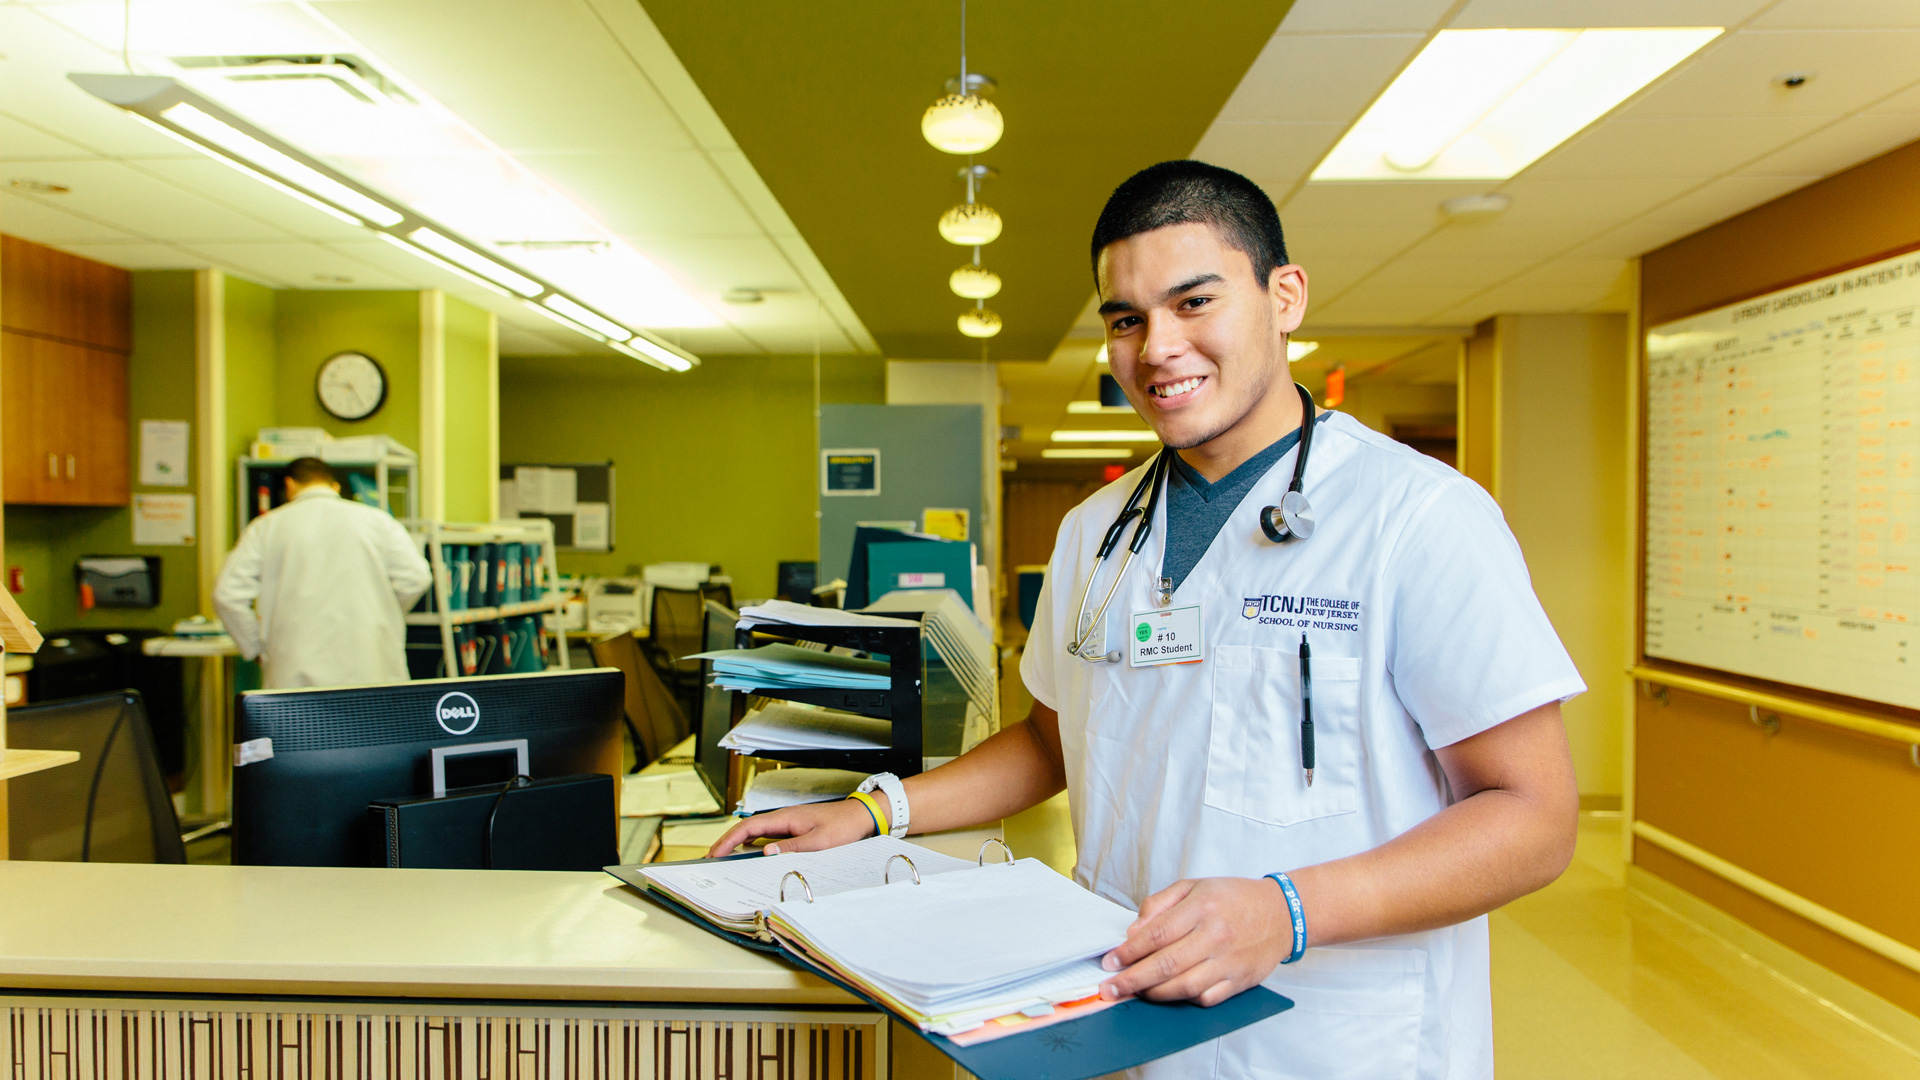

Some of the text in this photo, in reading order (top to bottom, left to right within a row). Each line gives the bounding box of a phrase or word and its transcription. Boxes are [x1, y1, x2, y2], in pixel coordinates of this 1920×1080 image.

[1740, 303, 1771, 320] FRONT
[1773, 285, 1838, 314] CARDIOLOGY
[1261, 594, 1305, 614] TCNJ
[1306, 597, 1360, 610] THE COLLEGE OF
[1305, 608, 1359, 619] NEW JERSEY
[1259, 617, 1358, 631] SCHOOL OF NURSING
[1157, 633, 1163, 642] #
[1165, 632, 1176, 641] 10
[1140, 643, 1192, 656] RMC Student
[441, 706, 475, 720] DELL
